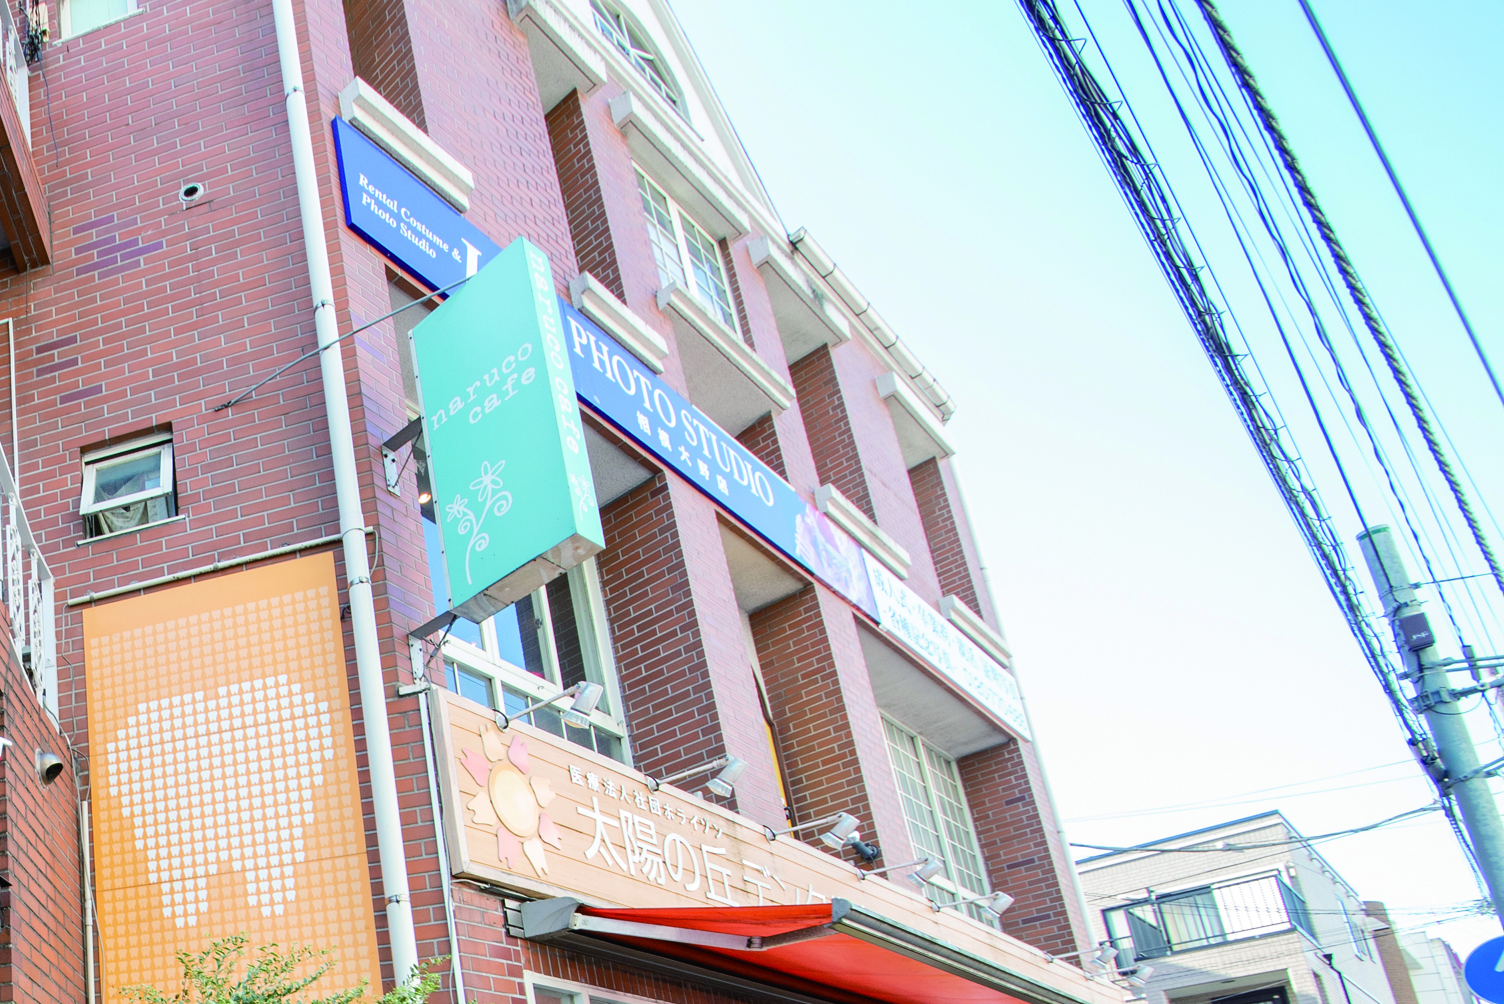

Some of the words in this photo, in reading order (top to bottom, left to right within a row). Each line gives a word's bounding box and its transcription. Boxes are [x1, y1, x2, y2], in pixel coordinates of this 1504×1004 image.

[359, 173, 398, 213] Rental
[400, 207, 449, 252] Costume
[451, 248, 462, 263] &
[362, 192, 397, 228] Photo
[400, 223, 437, 258] Studio
[431, 342, 533, 430] naruco
[469, 366, 536, 424] cafe
[530, 250, 565, 370] naruco
[555, 377, 581, 454] cafe
[567, 315, 677, 428] PHOTO
[681, 409, 774, 507] STUDIO
